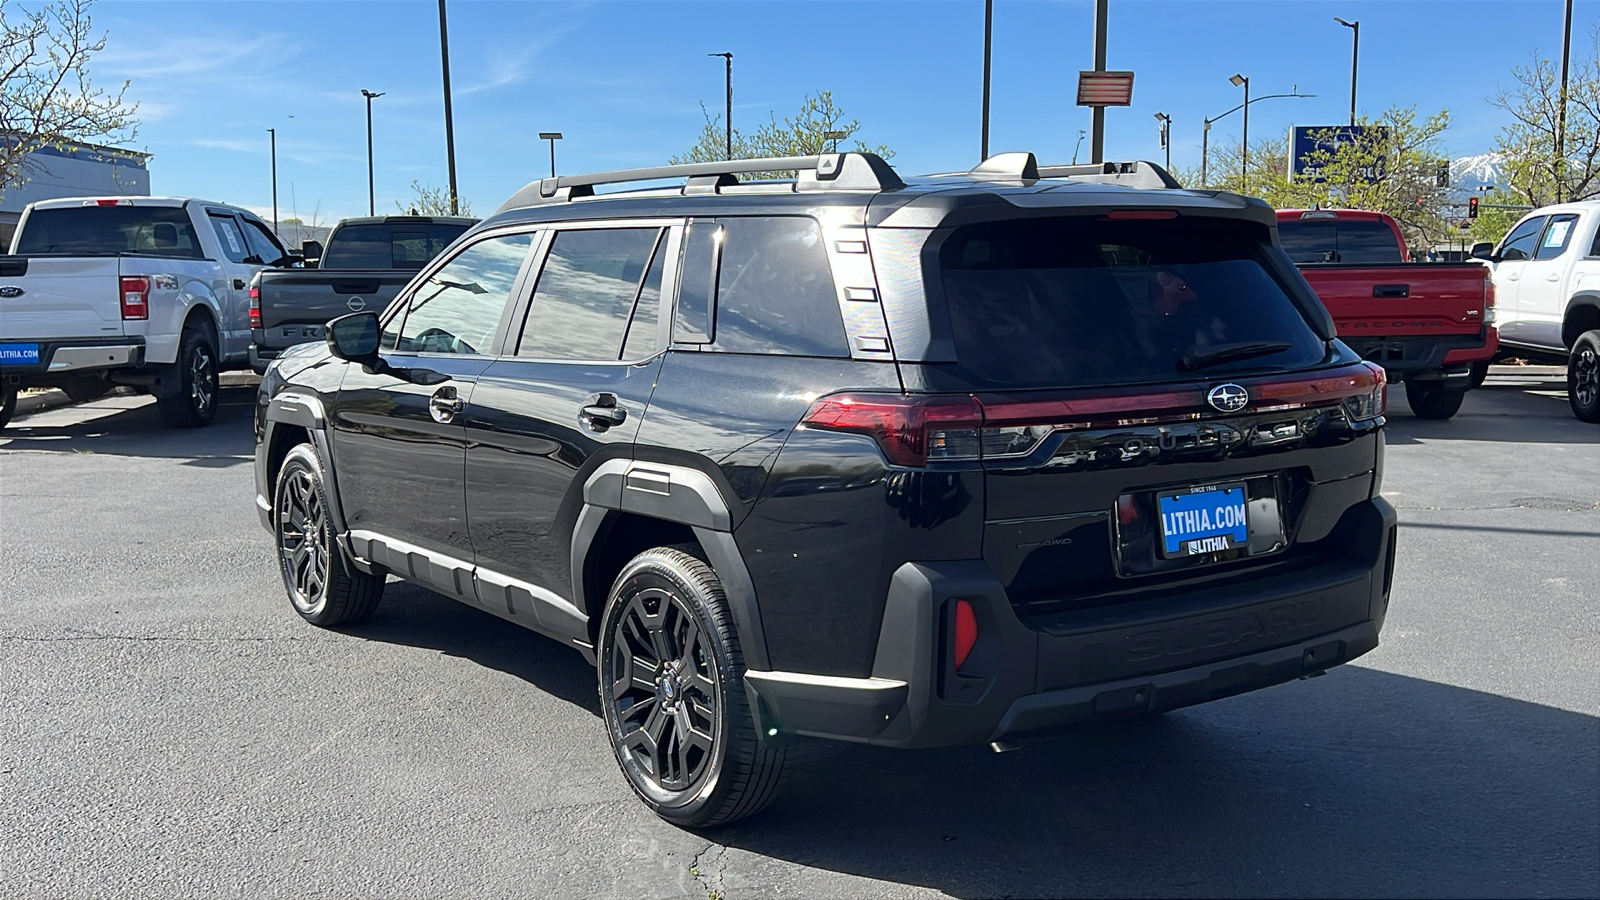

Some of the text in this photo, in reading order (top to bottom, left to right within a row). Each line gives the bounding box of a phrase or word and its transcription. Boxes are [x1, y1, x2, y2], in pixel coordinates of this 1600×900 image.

[282, 327, 327, 338] FR
[0, 350, 39, 359] LITHIA.COM
[1123, 418, 1312, 453] OUTBACK
[1190, 486, 1205, 494] SINCE
[1162, 504, 1246, 536] LITHIA.COM
[1040, 538, 1072, 547] AWD
[1197, 536, 1229, 554] LITHIA
[1126, 597, 1325, 662] SUBARU
